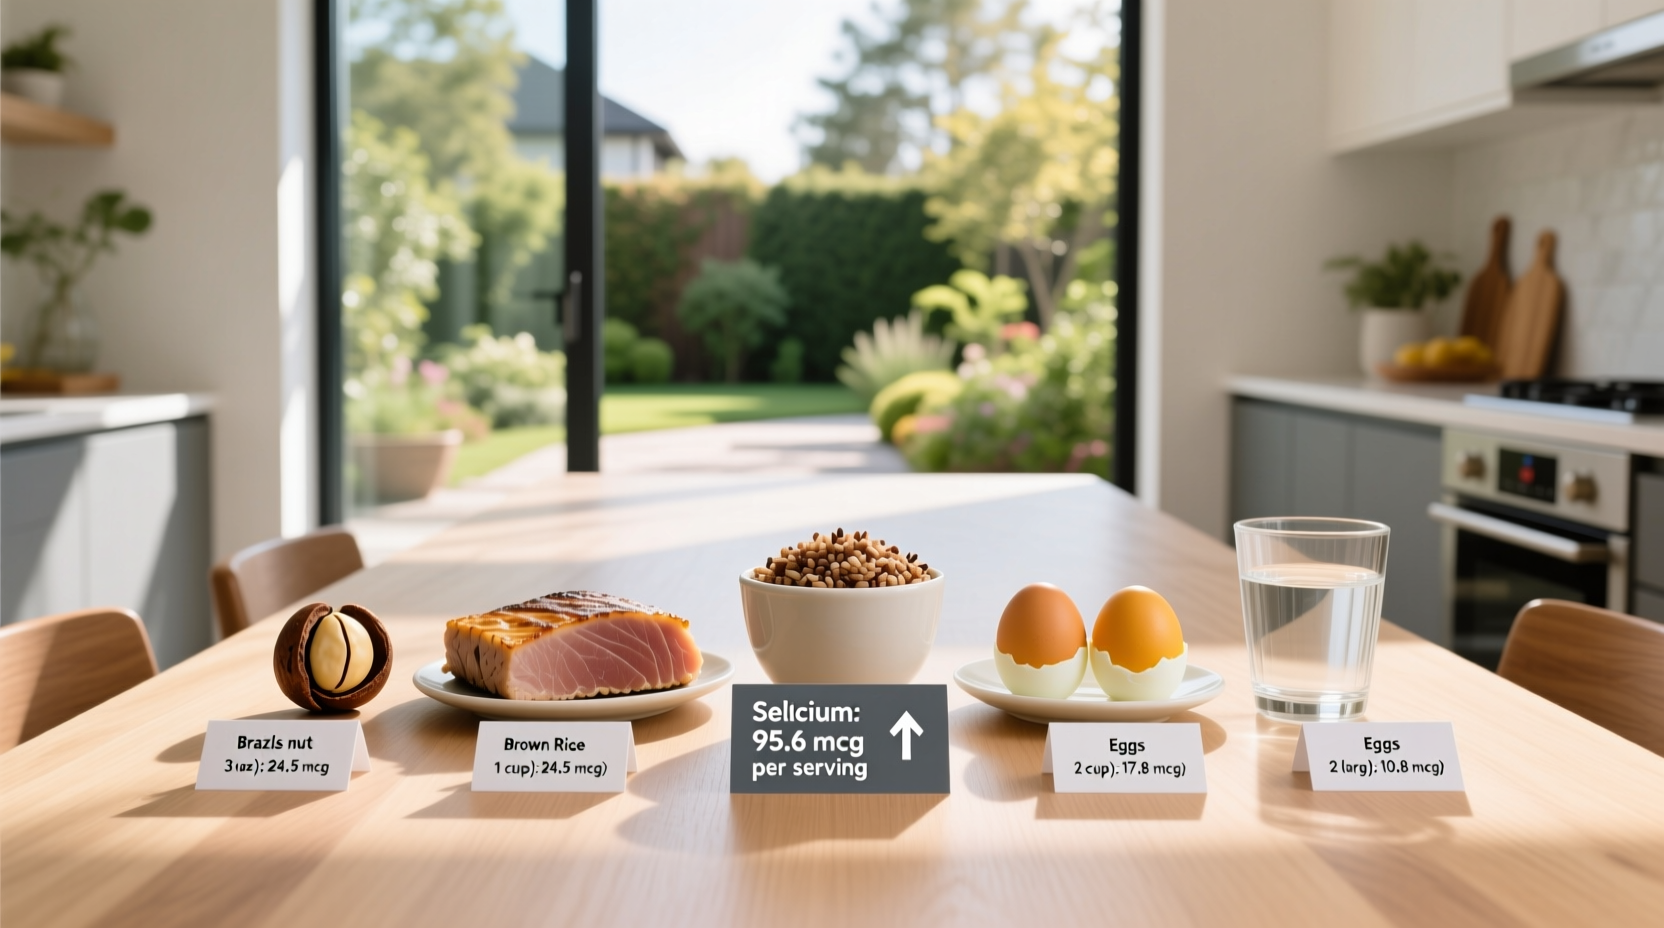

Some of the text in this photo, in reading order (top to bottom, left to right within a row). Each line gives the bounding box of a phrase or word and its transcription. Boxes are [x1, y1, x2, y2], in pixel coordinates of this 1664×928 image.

[287, 735, 314, 750] nut
[503, 736, 586, 752] Brown Rice
[752, 729, 864, 758] 95.6 mcg
[1109, 737, 1146, 756] Eggs
[1363, 736, 1401, 754] Eggs
[224, 758, 234, 773] 3
[266, 758, 300, 773] 24.5
[302, 762, 330, 777] mcg
[494, 760, 608, 778] 1 cup): 24.5 mcg)
[752, 758, 868, 782] per serving
[1074, 761, 1083, 775] 2
[1121, 760, 1150, 775] 17.8
[1153, 762, 1186, 778] mcg)
[1328, 759, 1339, 773] 2
[1380, 759, 1409, 774] 10.8
[1411, 759, 1445, 777] mcg)
